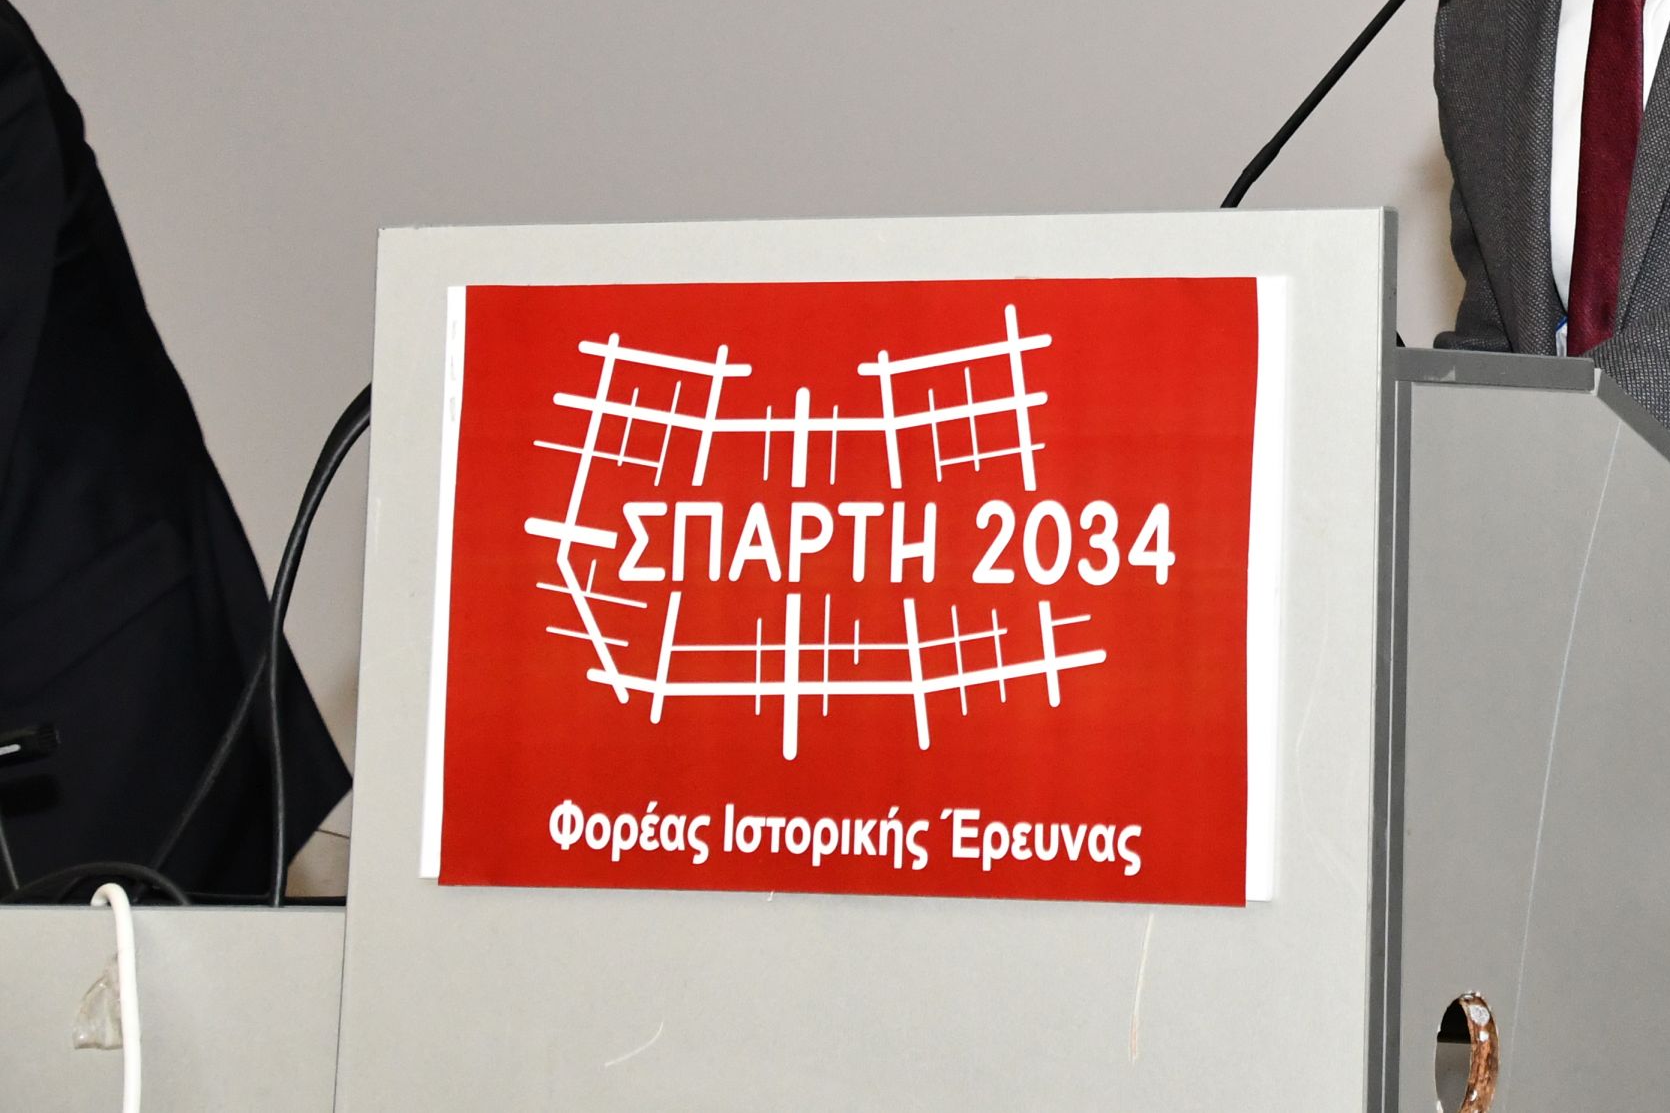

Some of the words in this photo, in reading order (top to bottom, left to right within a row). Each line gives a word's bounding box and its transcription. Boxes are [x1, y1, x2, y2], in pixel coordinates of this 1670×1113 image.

[618, 500, 938, 583] ΣΠΑΡΤΗ
[972, 499, 1176, 586] 2034
[548, 799, 711, 865] Φορέας
[723, 803, 930, 871] Ιστορικής
[940, 808, 1143, 876] Έρευνας
